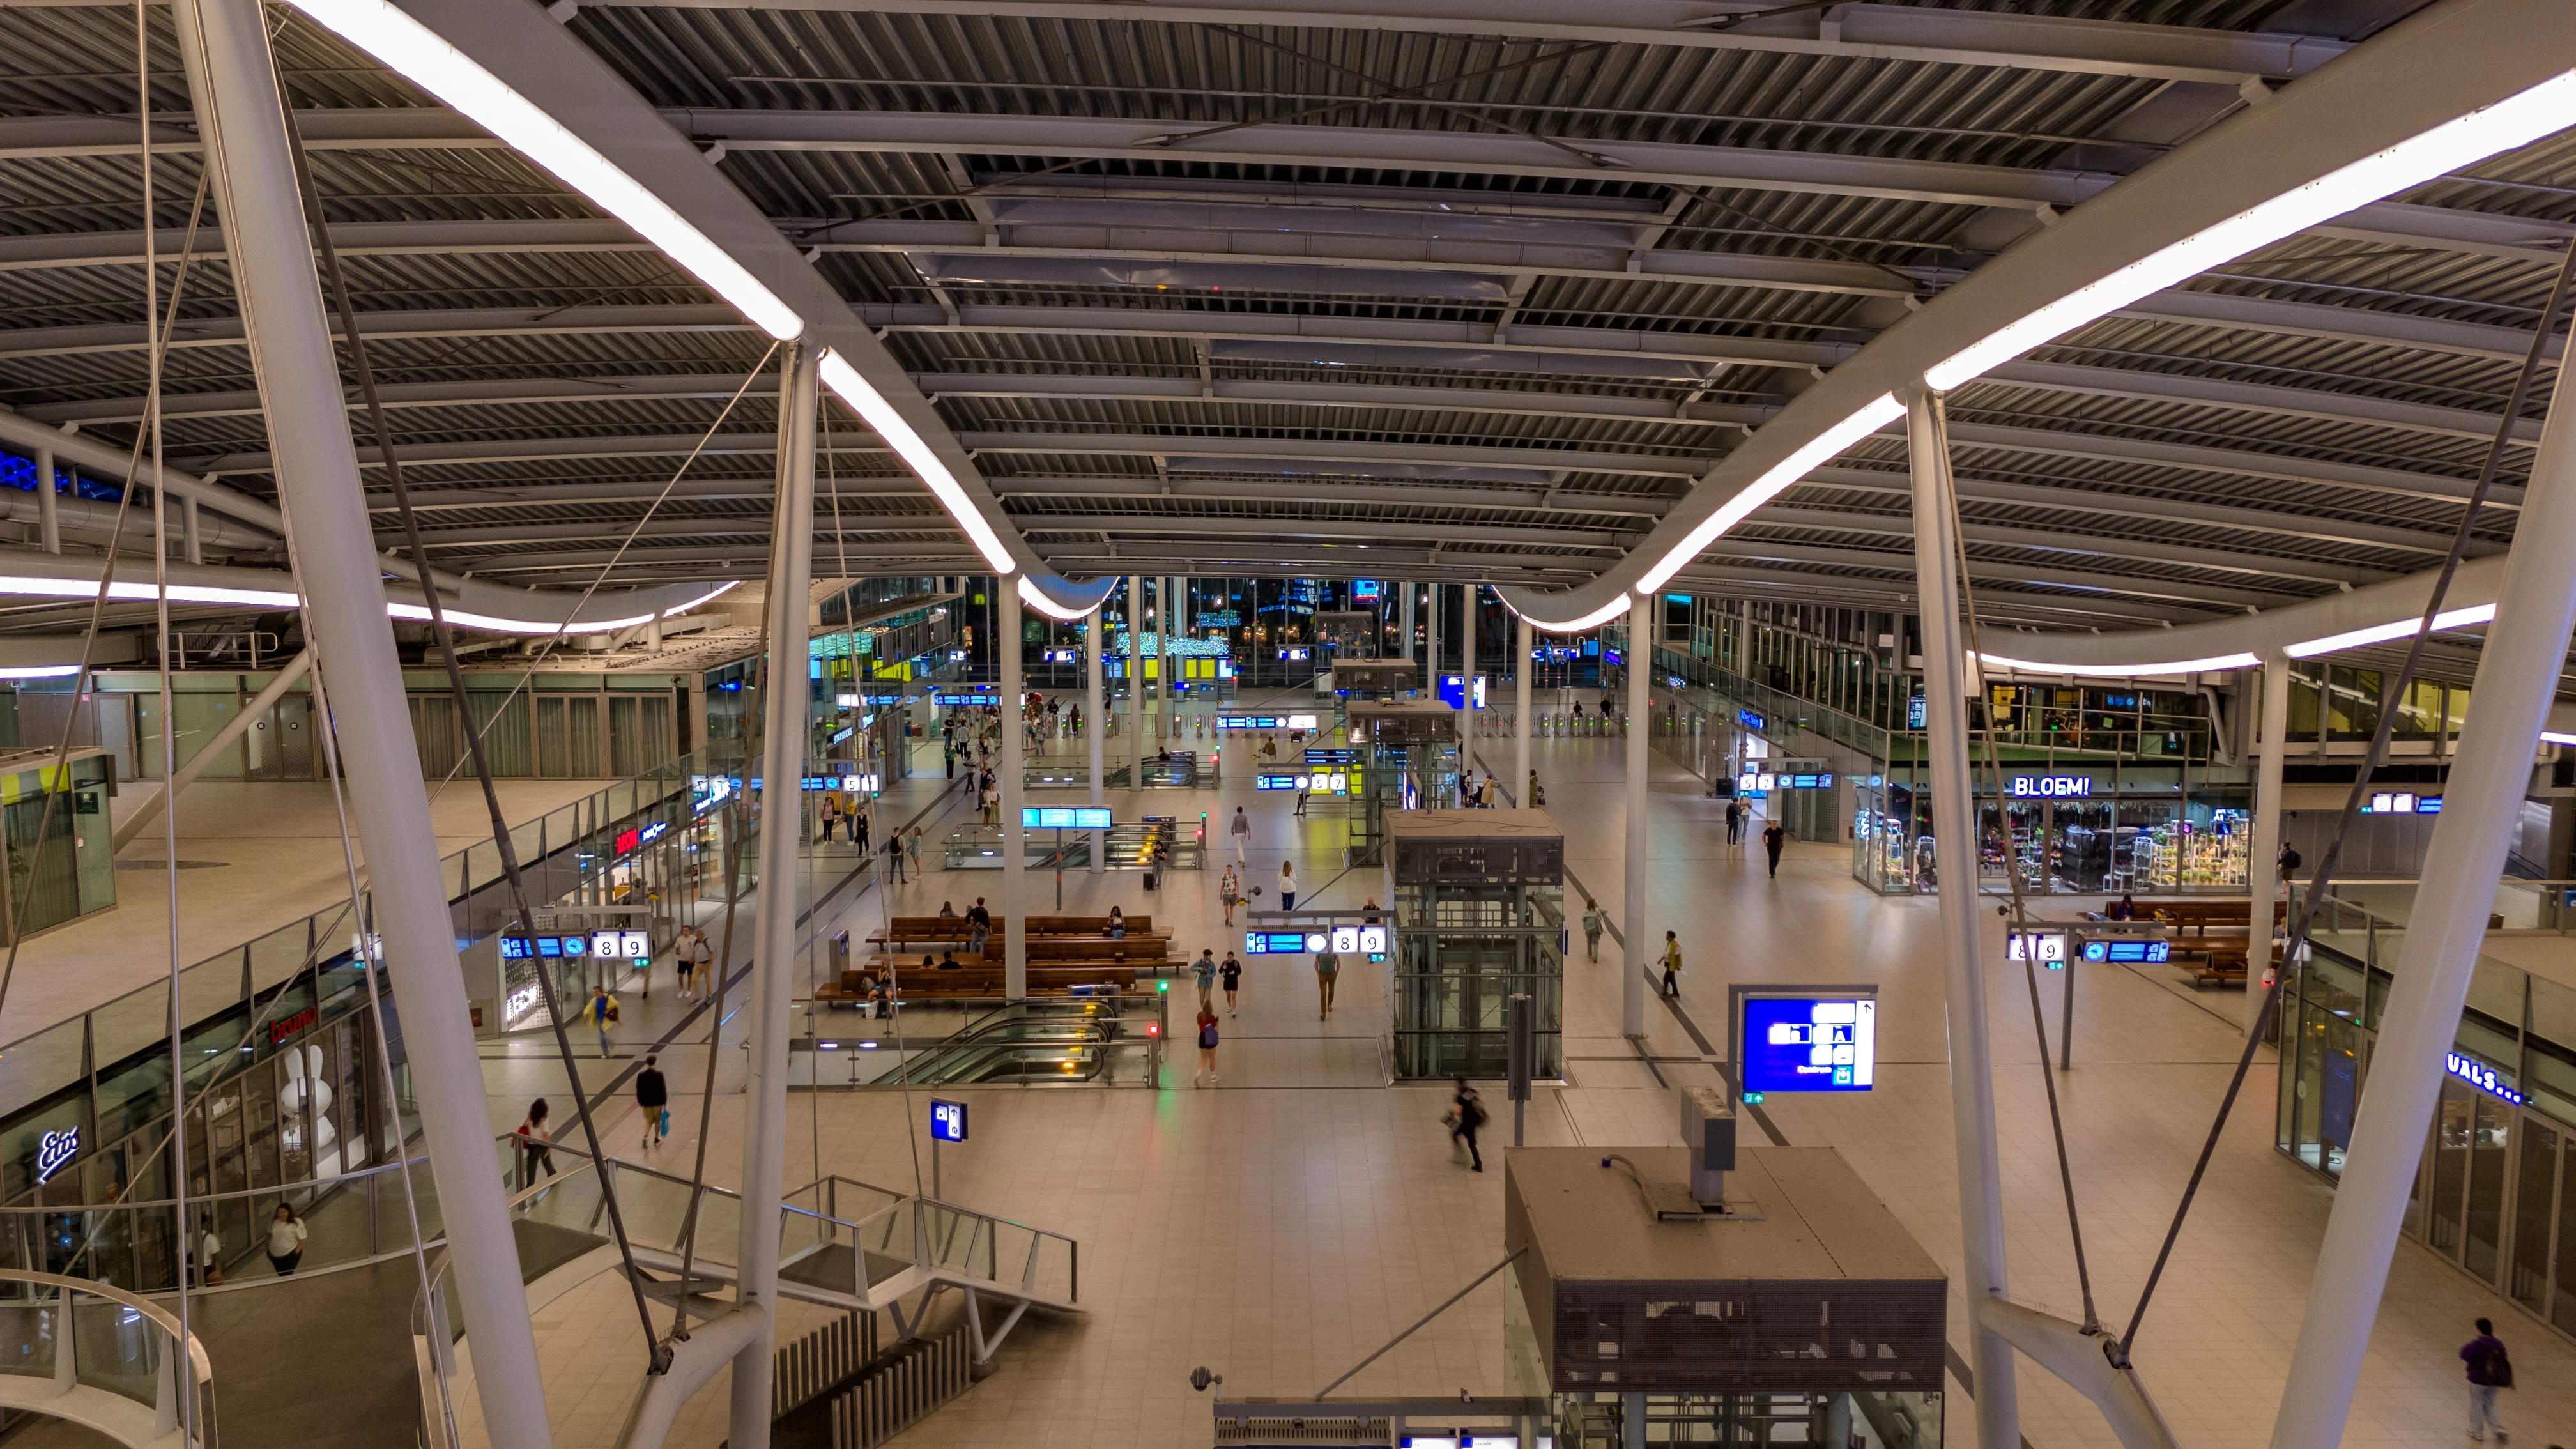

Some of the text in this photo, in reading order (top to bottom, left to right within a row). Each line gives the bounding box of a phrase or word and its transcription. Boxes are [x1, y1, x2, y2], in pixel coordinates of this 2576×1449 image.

[834, 726, 852, 745] STARBUCKS
[849, 781, 855, 790] 5
[1317, 779, 1322, 788] 5
[1335, 779, 1341, 788] 7
[1745, 779, 1751, 788] 5
[1764, 779, 1769, 788] 7
[2014, 778, 2089, 796] BLOEM!
[602, 941, 611, 955] 8
[630, 941, 640, 955] 9
[1340, 937, 1349, 950] 8
[1368, 937, 1377, 950] 9
[2018, 944, 2026, 958] 8
[2046, 944, 2055, 958] 9
[269, 1007, 317, 1044] bruno
[1834, 1030, 1846, 1042] A
